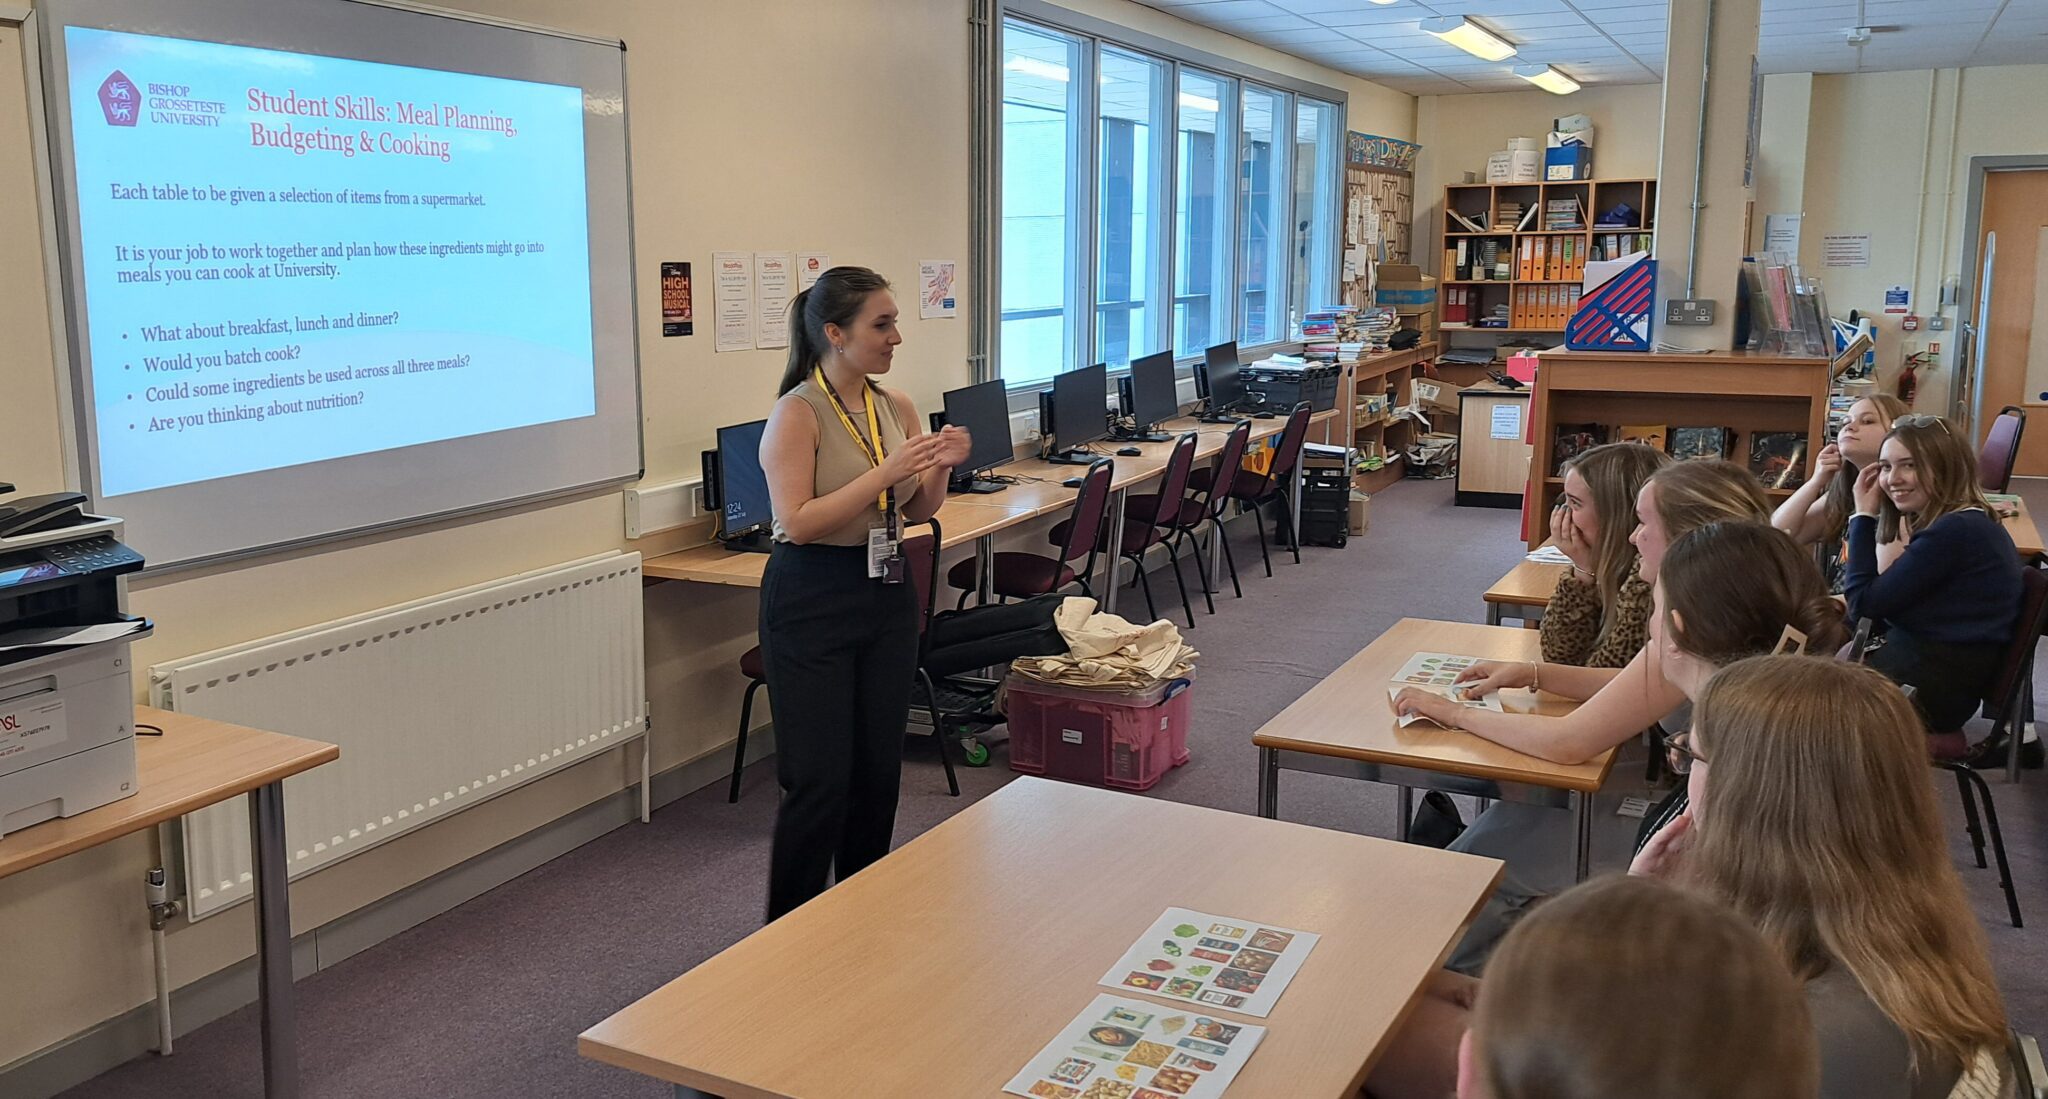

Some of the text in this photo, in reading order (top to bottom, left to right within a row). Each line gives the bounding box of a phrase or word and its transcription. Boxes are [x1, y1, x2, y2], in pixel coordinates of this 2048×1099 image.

[149, 83, 190, 97] BISHOP
[149, 97, 226, 113] GROSSETESTE
[247, 88, 517, 137] Student Skills: Meal Planning,
[151, 112, 220, 127] UNIVERSITY
[251, 122, 450, 162] Budgeting & Cooking
[111, 183, 486, 208] Each table to be given a selection of items from a supermarket.
[115, 240, 544, 264] It is your job to work together and plan how these ingredients might go into
[118, 263, 340, 285] meals you can cook at University.
[663, 277, 689, 289] HIGH
[663, 290, 690, 299] SCHOOL
[663, 299, 690, 310] MUSICAL
[141, 311, 399, 342] What about breakfast, lunch and dinner?
[144, 345, 300, 373] Would you batch cook?
[146, 354, 470, 402] Could some ingredients be used across all three meals?
[148, 391, 364, 432] Are you thinking about nutrition?
